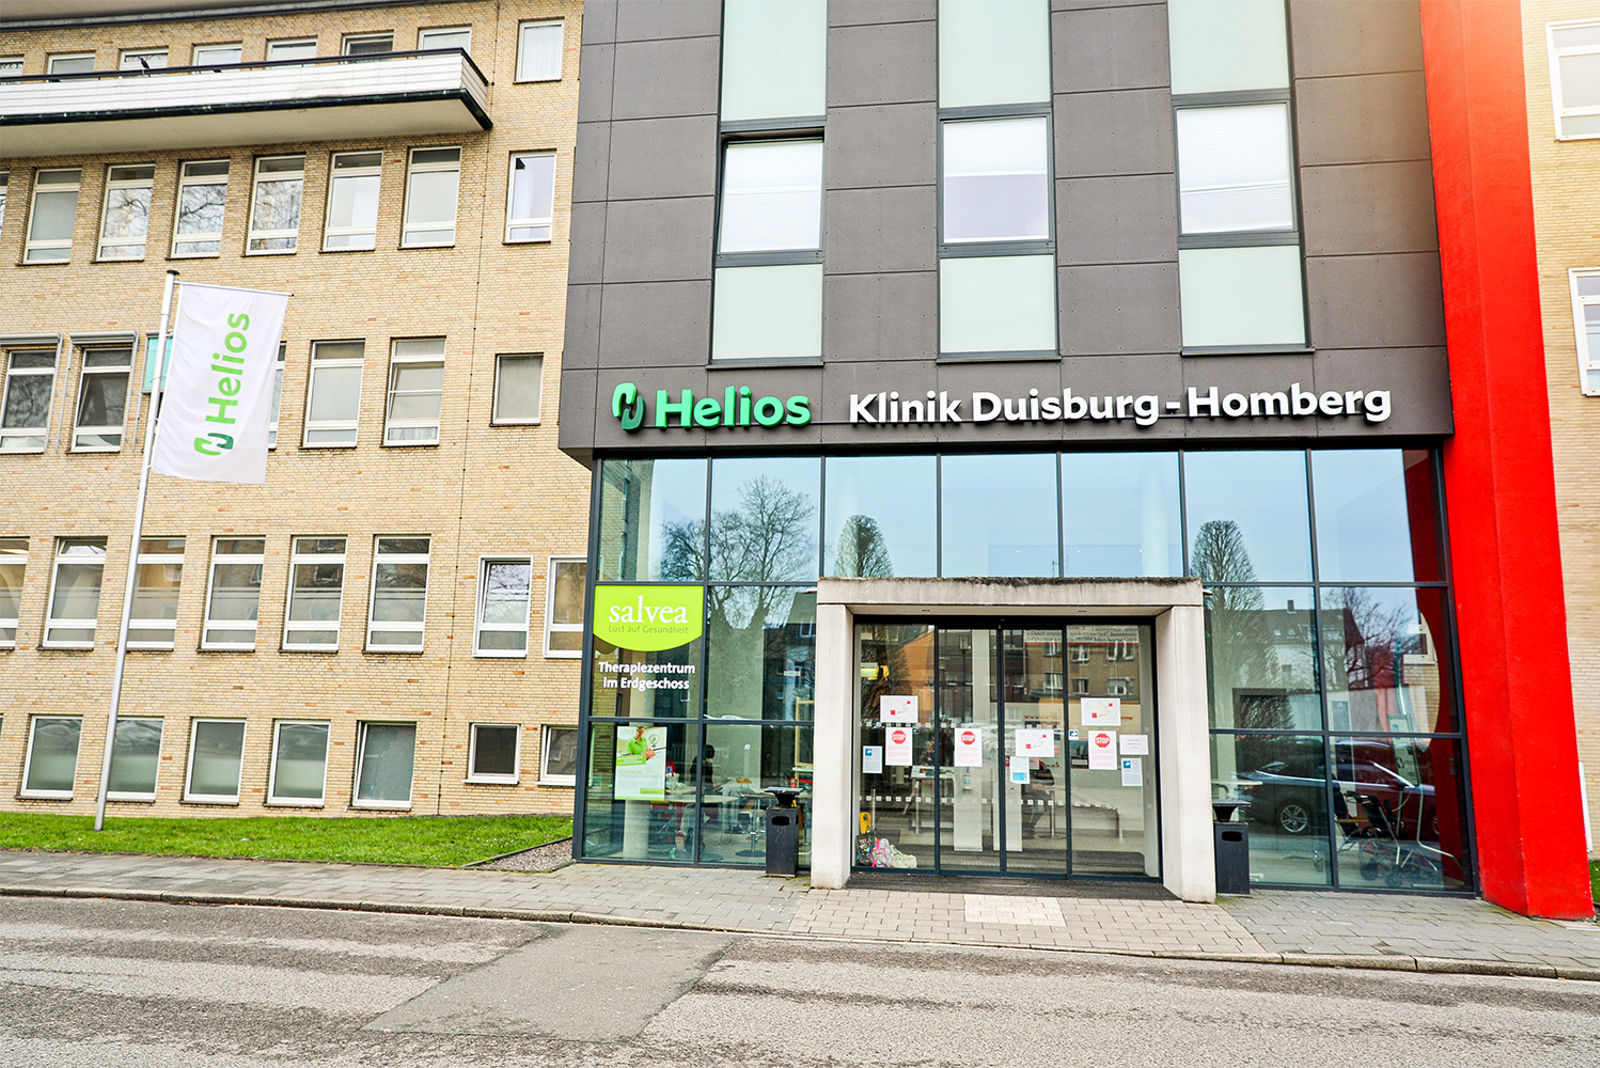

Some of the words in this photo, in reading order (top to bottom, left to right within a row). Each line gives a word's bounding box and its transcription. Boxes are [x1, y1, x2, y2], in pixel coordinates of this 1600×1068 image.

[205, 313, 250, 425] Helios
[656, 385, 812, 428] Helios
[849, 390, 962, 423] Klinik
[608, 595, 689, 624] salvea
[608, 625, 625, 633] Lust
[627, 625, 641, 633] auf
[643, 625, 689, 634] Gesundheit
[598, 661, 696, 676] Therapiezentrum
[620, 677, 690, 692] Erdgeschoss
